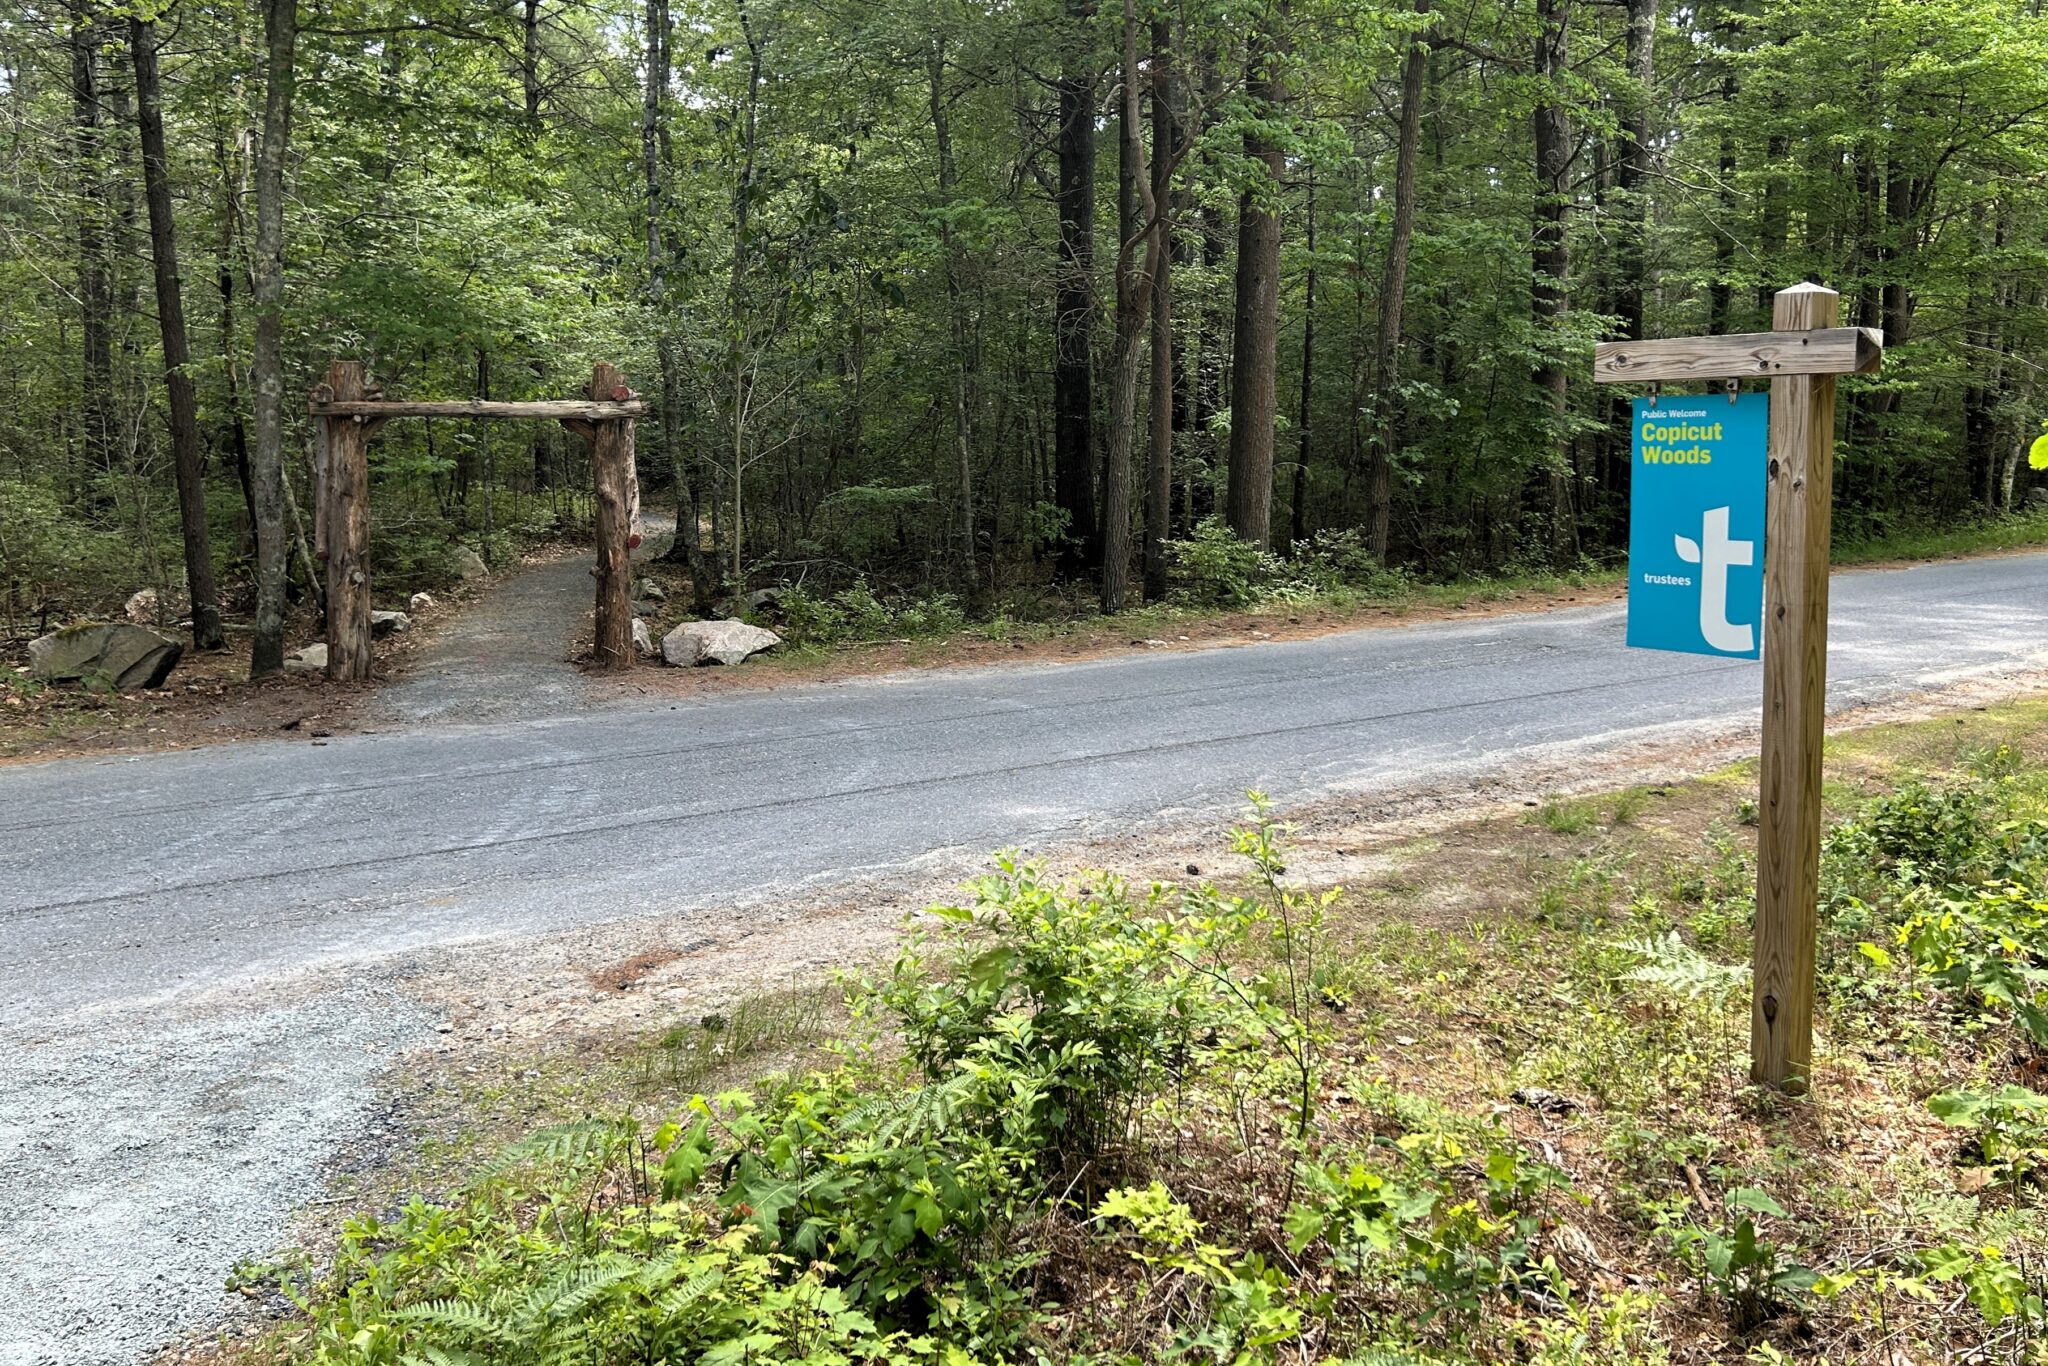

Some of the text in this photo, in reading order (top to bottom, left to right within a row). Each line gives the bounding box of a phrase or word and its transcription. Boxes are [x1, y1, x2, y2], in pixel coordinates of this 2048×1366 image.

[1642, 409, 1707, 419] Public Welcome
[1642, 421, 1723, 445] Copicut
[1641, 445, 1712, 464] Woods
[1644, 573, 1691, 586] trustees
